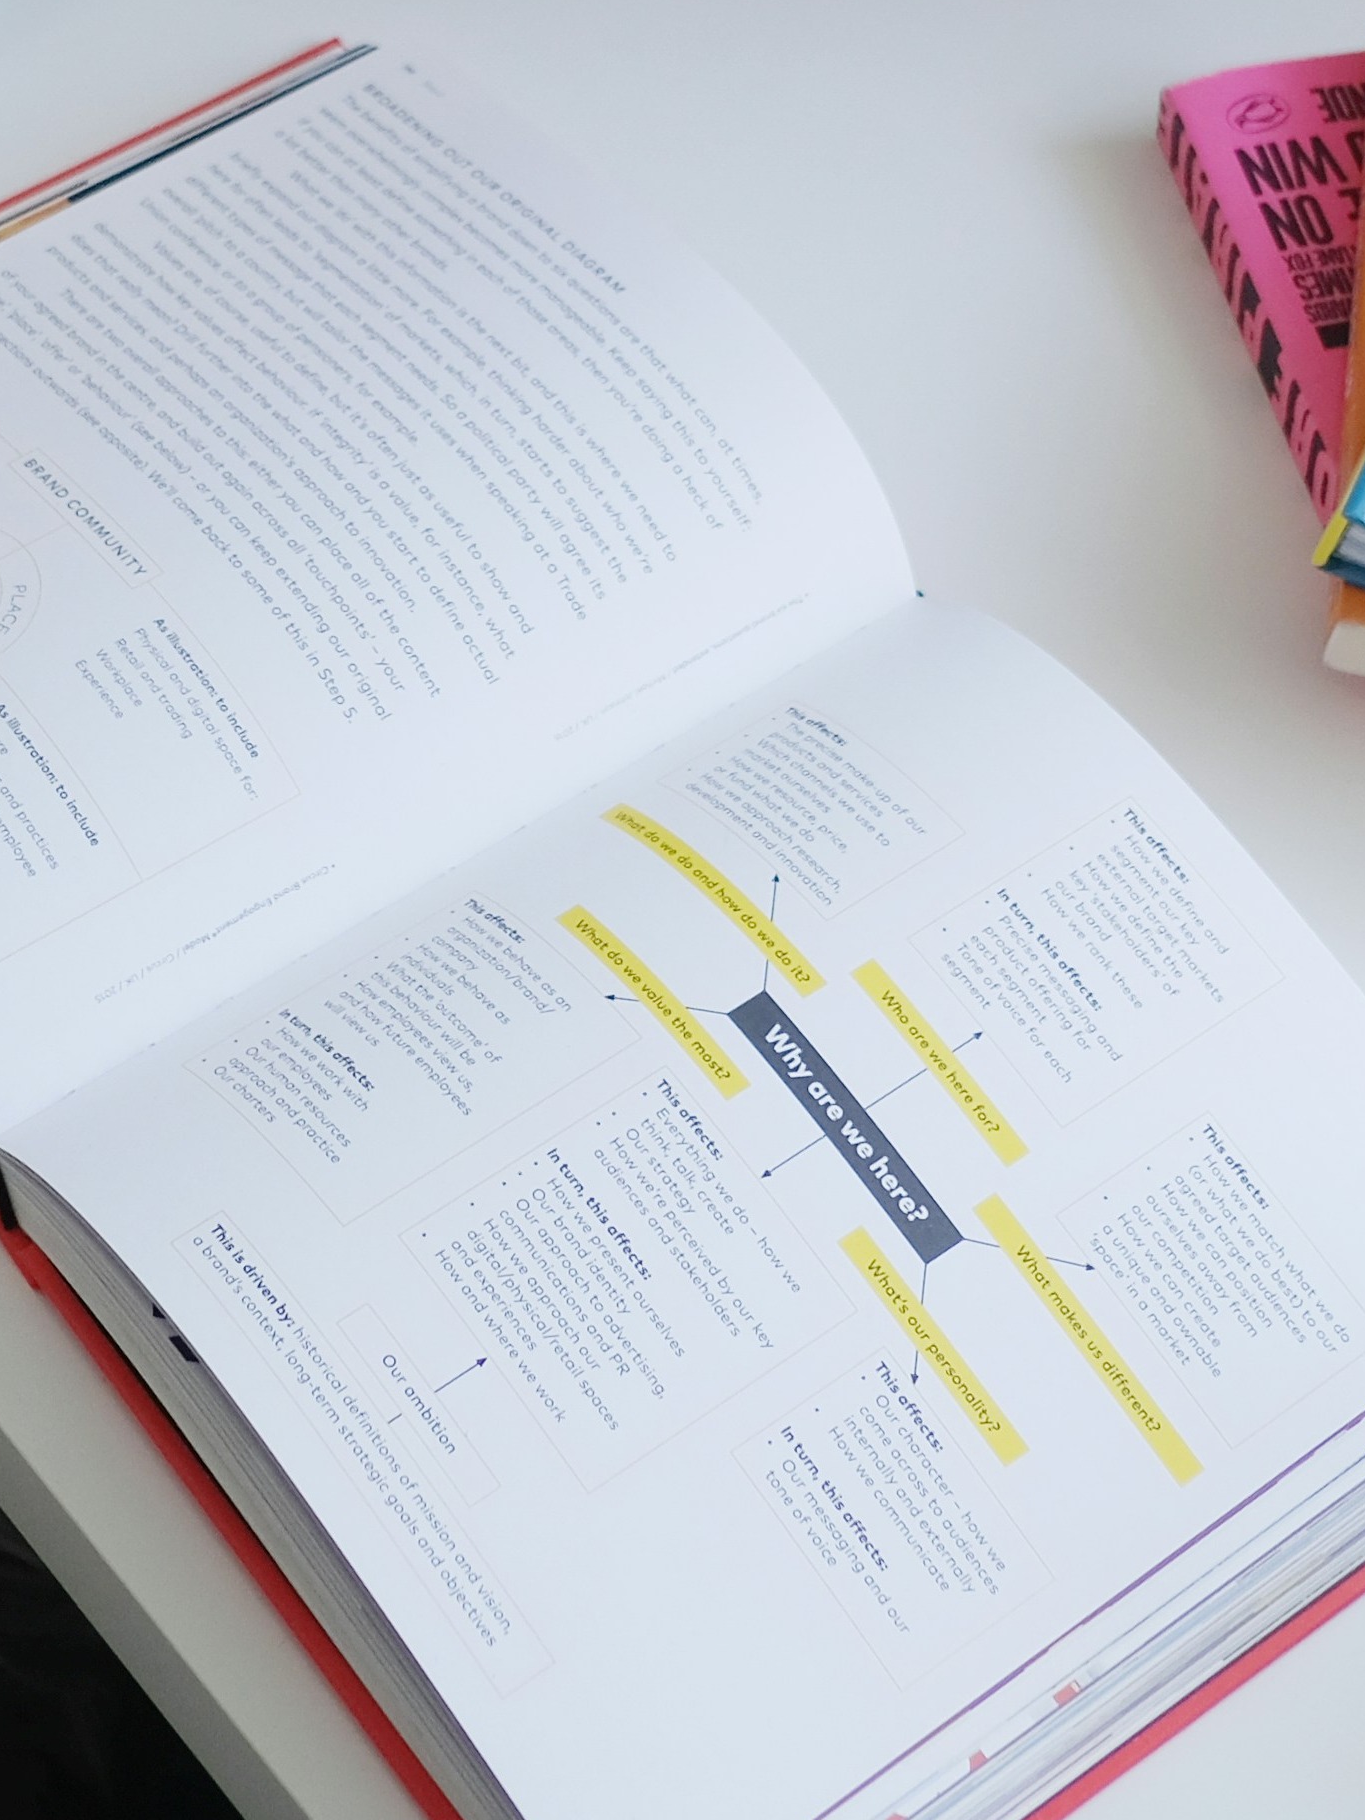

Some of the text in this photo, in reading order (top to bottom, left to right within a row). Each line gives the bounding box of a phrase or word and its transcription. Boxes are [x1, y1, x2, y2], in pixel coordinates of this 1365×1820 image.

[21, 456, 148, 578] BRAND COMMUNITY
[614, 810, 810, 984] What do we do and how do we do it?
[575, 916, 733, 1081] What do we value the most?
[881, 989, 1001, 1133] Who are we here for?
[763, 1019, 930, 1224] Why are we here?
[866, 1258, 1002, 1435] What's our personality?
[1017, 1244, 1162, 1434] What makes us different?
